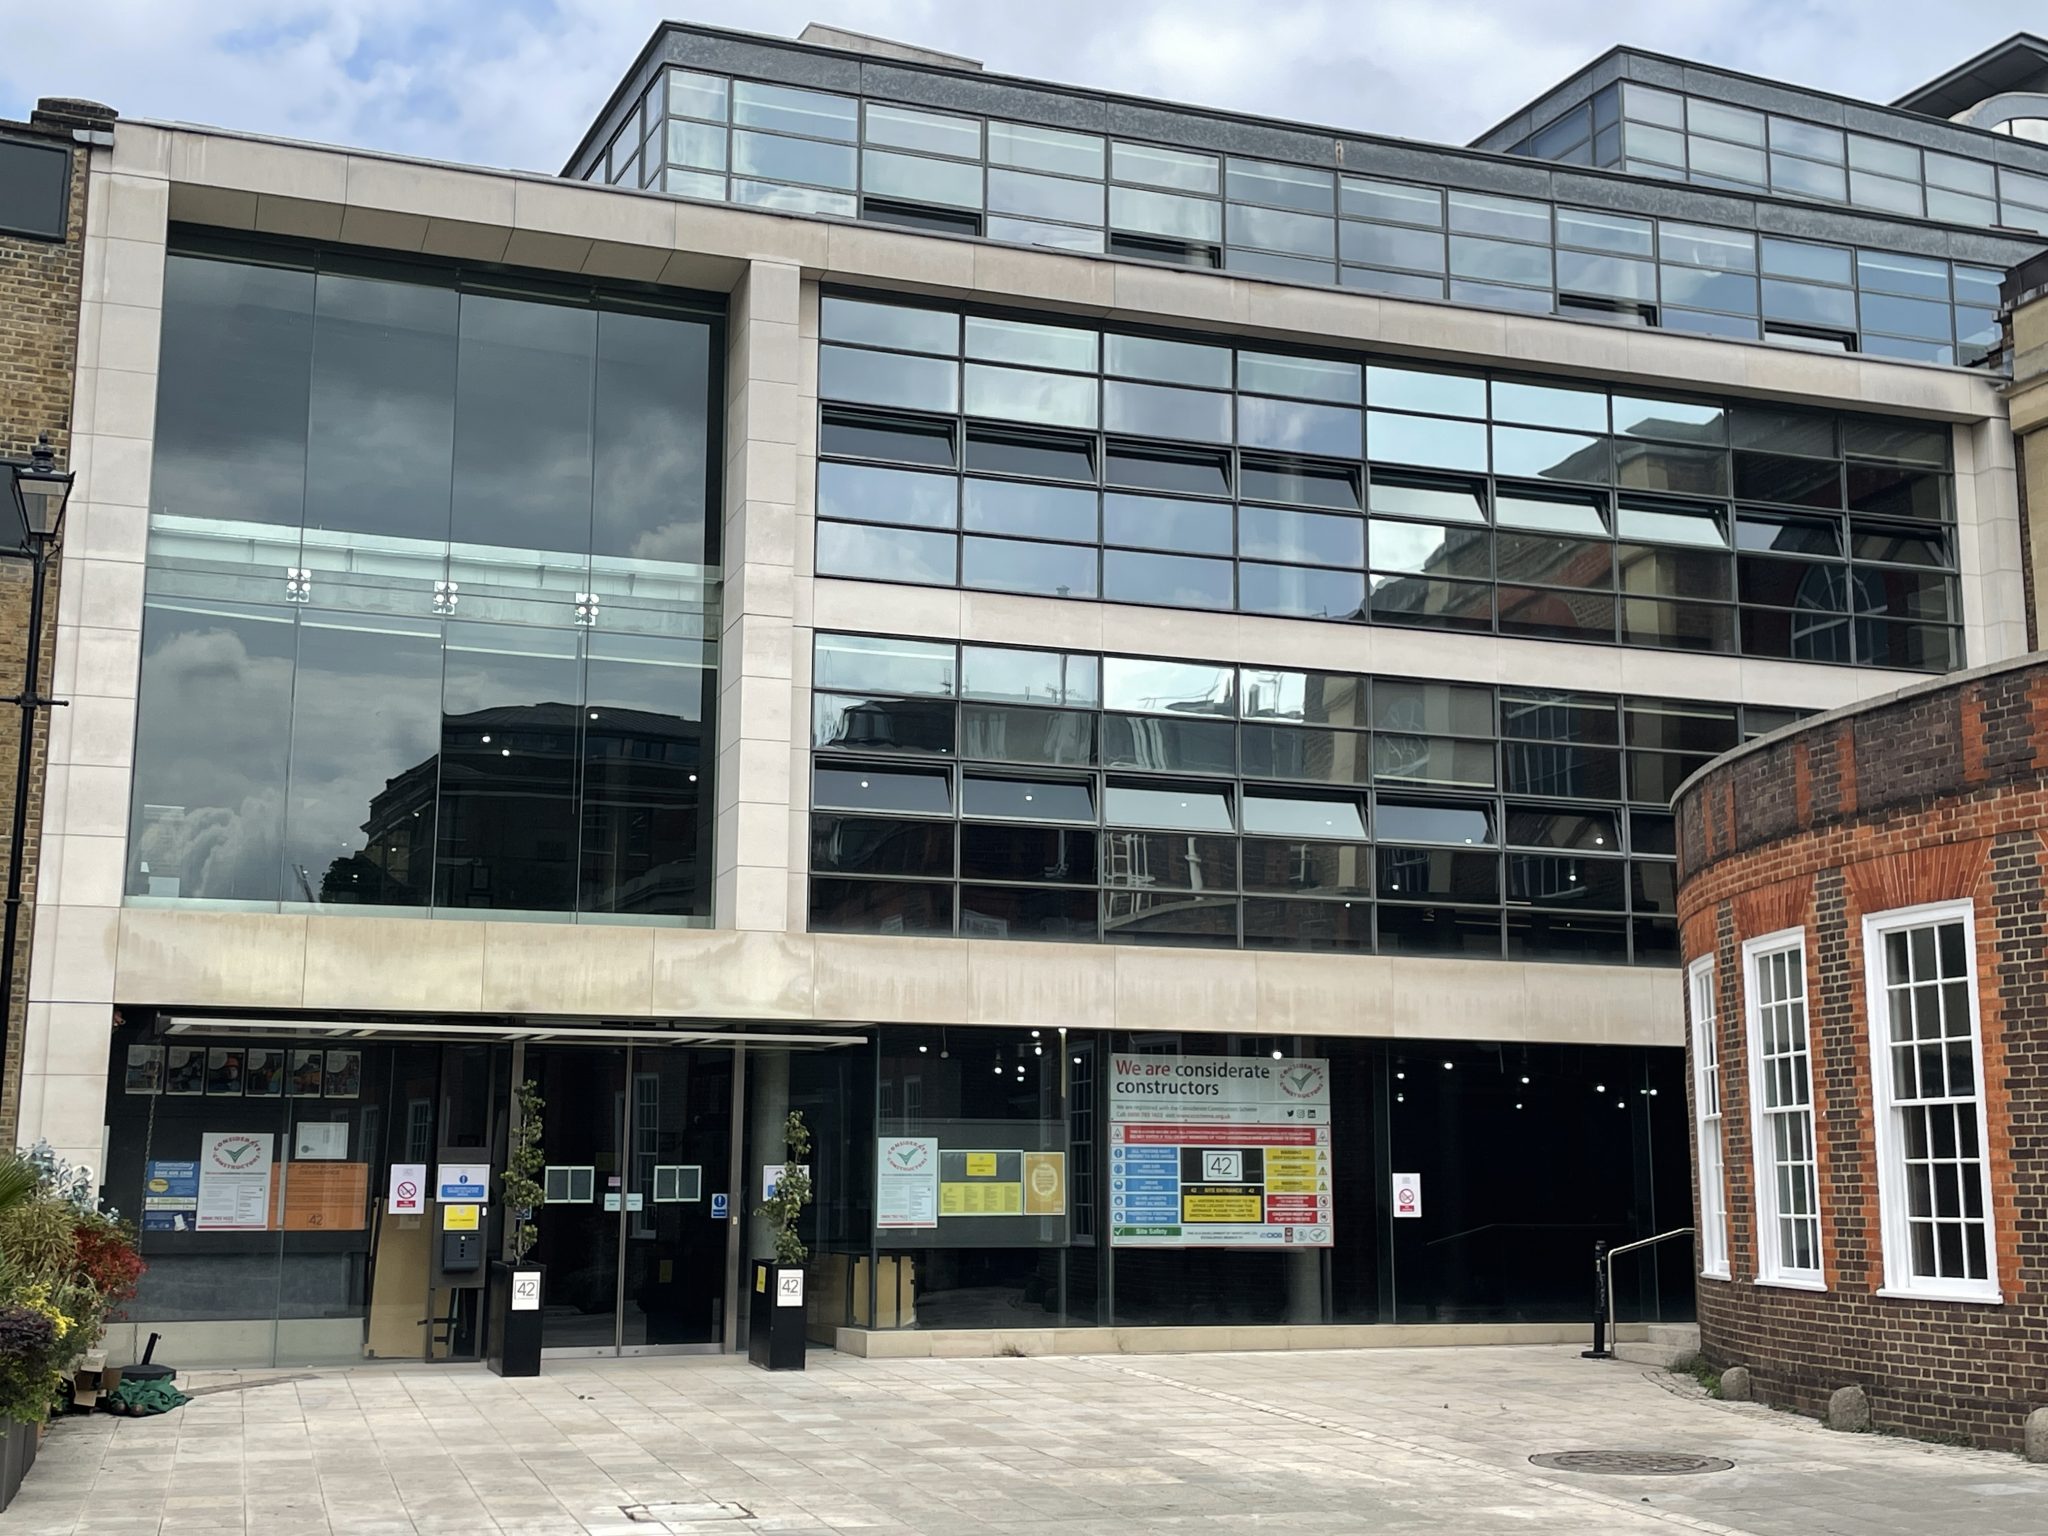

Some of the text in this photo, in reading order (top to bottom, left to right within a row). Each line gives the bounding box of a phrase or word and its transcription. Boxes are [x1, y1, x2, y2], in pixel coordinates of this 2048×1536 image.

[1115, 1060, 1270, 1079] We are considerate
[1116, 1080, 1219, 1095] constructors
[214, 1136, 261, 1152] CONSIDERATE
[1210, 1157, 1232, 1174] 42
[309, 1214, 323, 1226] 42
[517, 1282, 535, 1296] 42
[782, 1279, 799, 1293] 42
